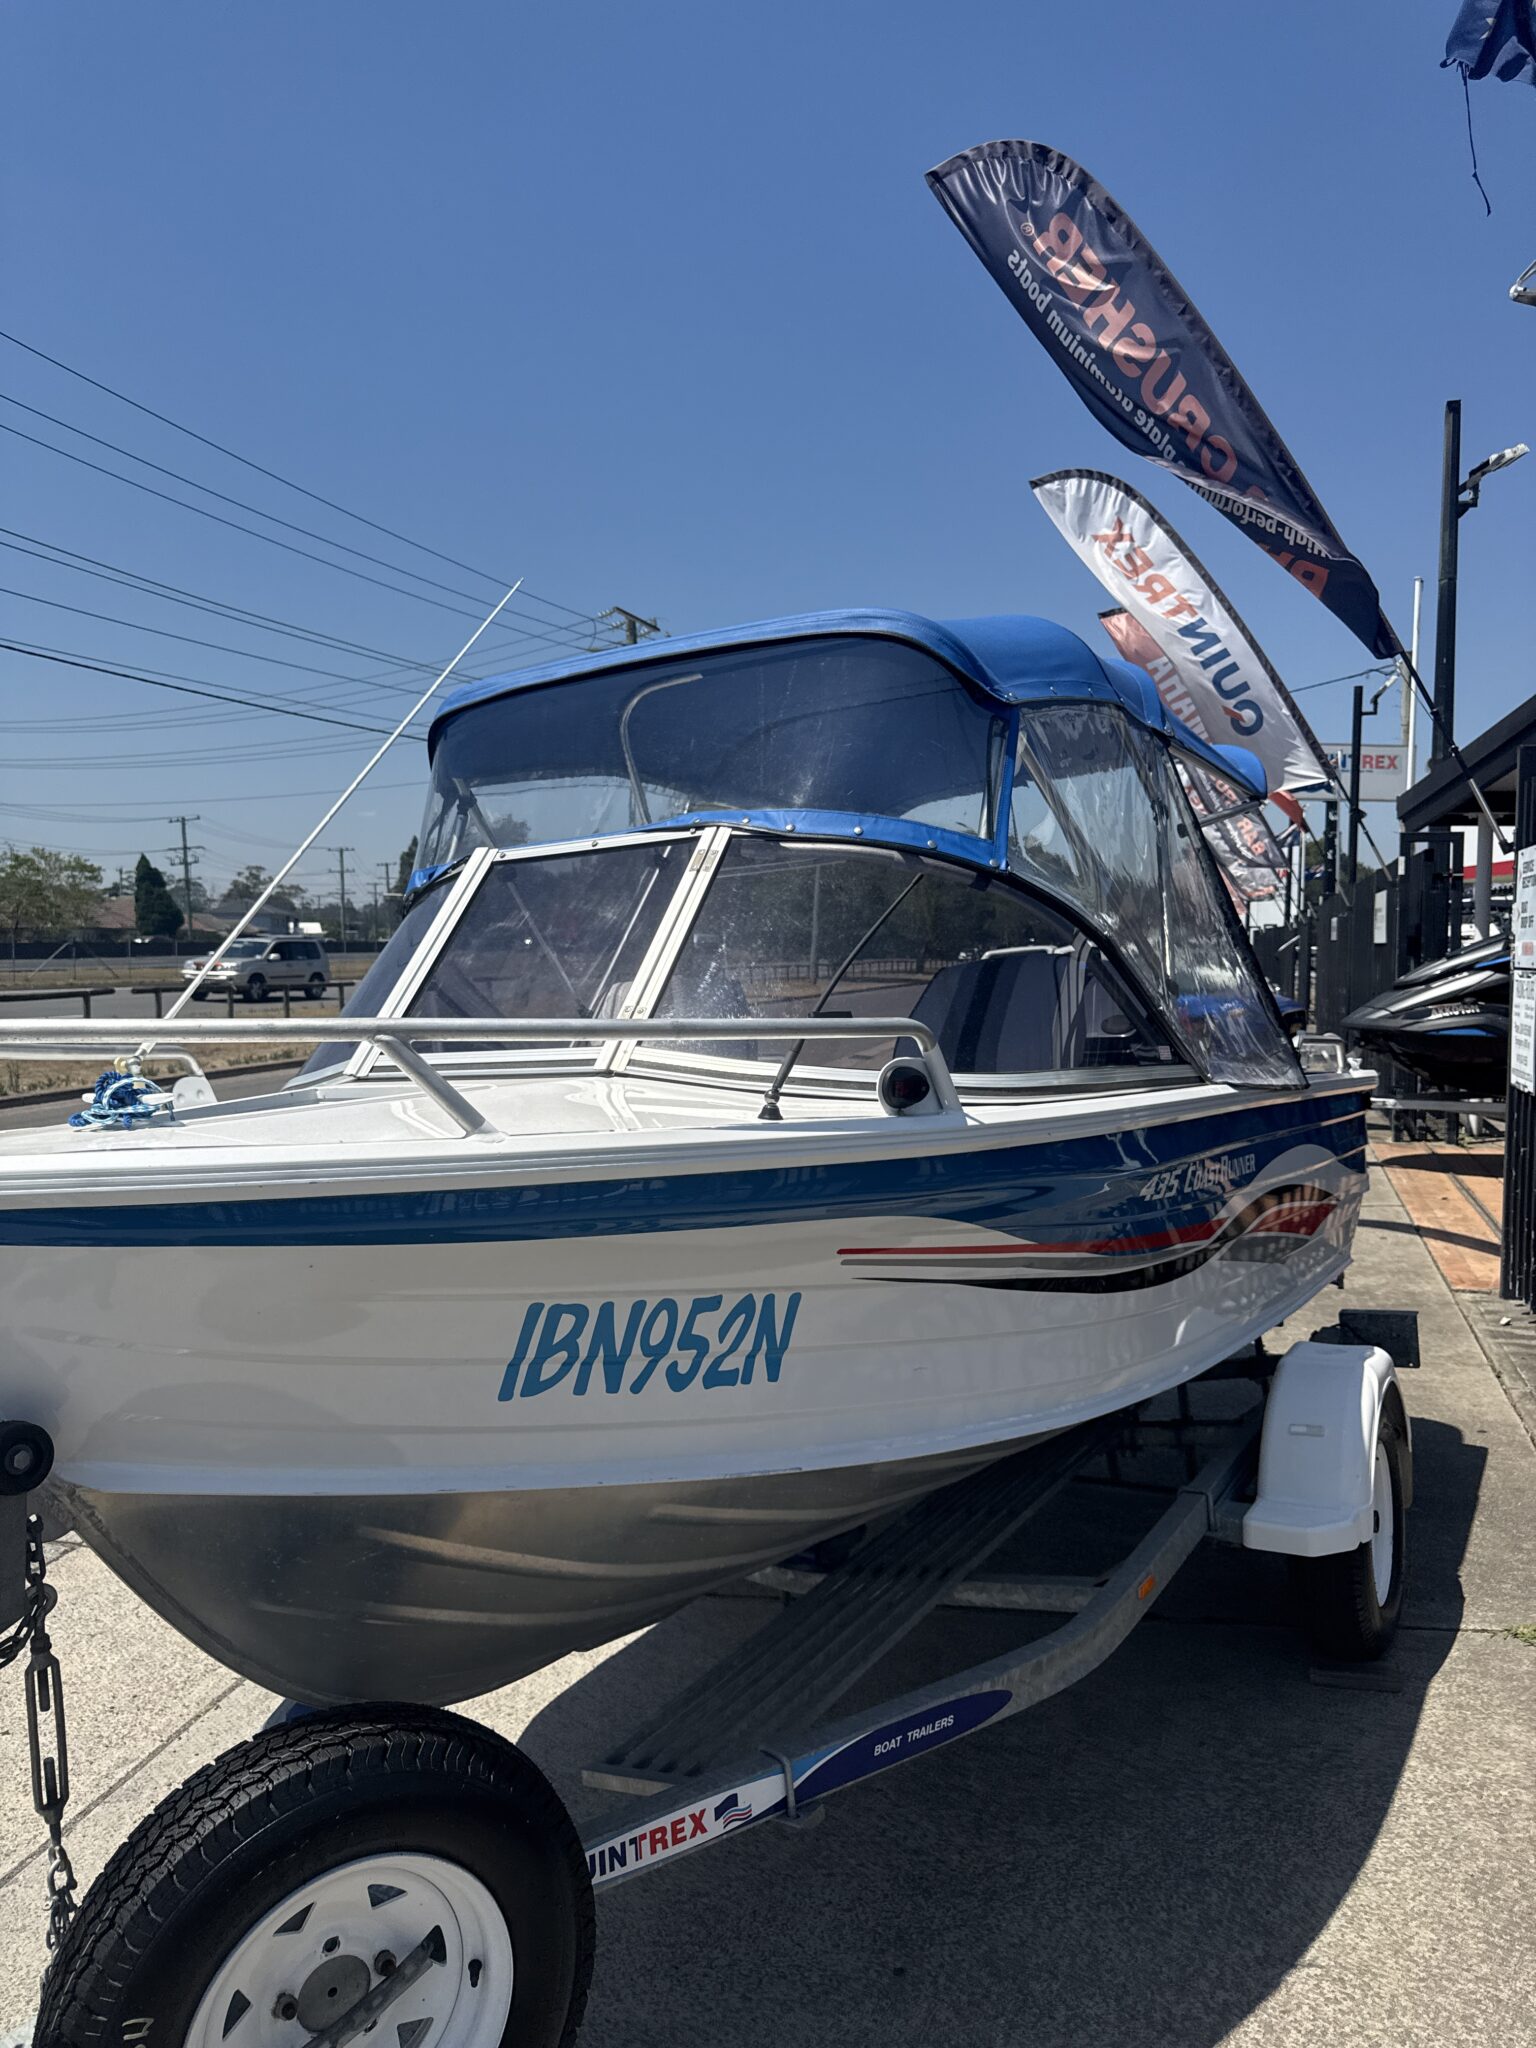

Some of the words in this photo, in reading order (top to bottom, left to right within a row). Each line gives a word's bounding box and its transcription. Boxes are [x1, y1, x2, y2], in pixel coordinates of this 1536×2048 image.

[498, 1292, 802, 1402] IBN952N
[874, 1735, 902, 1757] BOAT
[906, 1714, 955, 1743] TRAILERS
[588, 1808, 708, 1880] UINTREX
